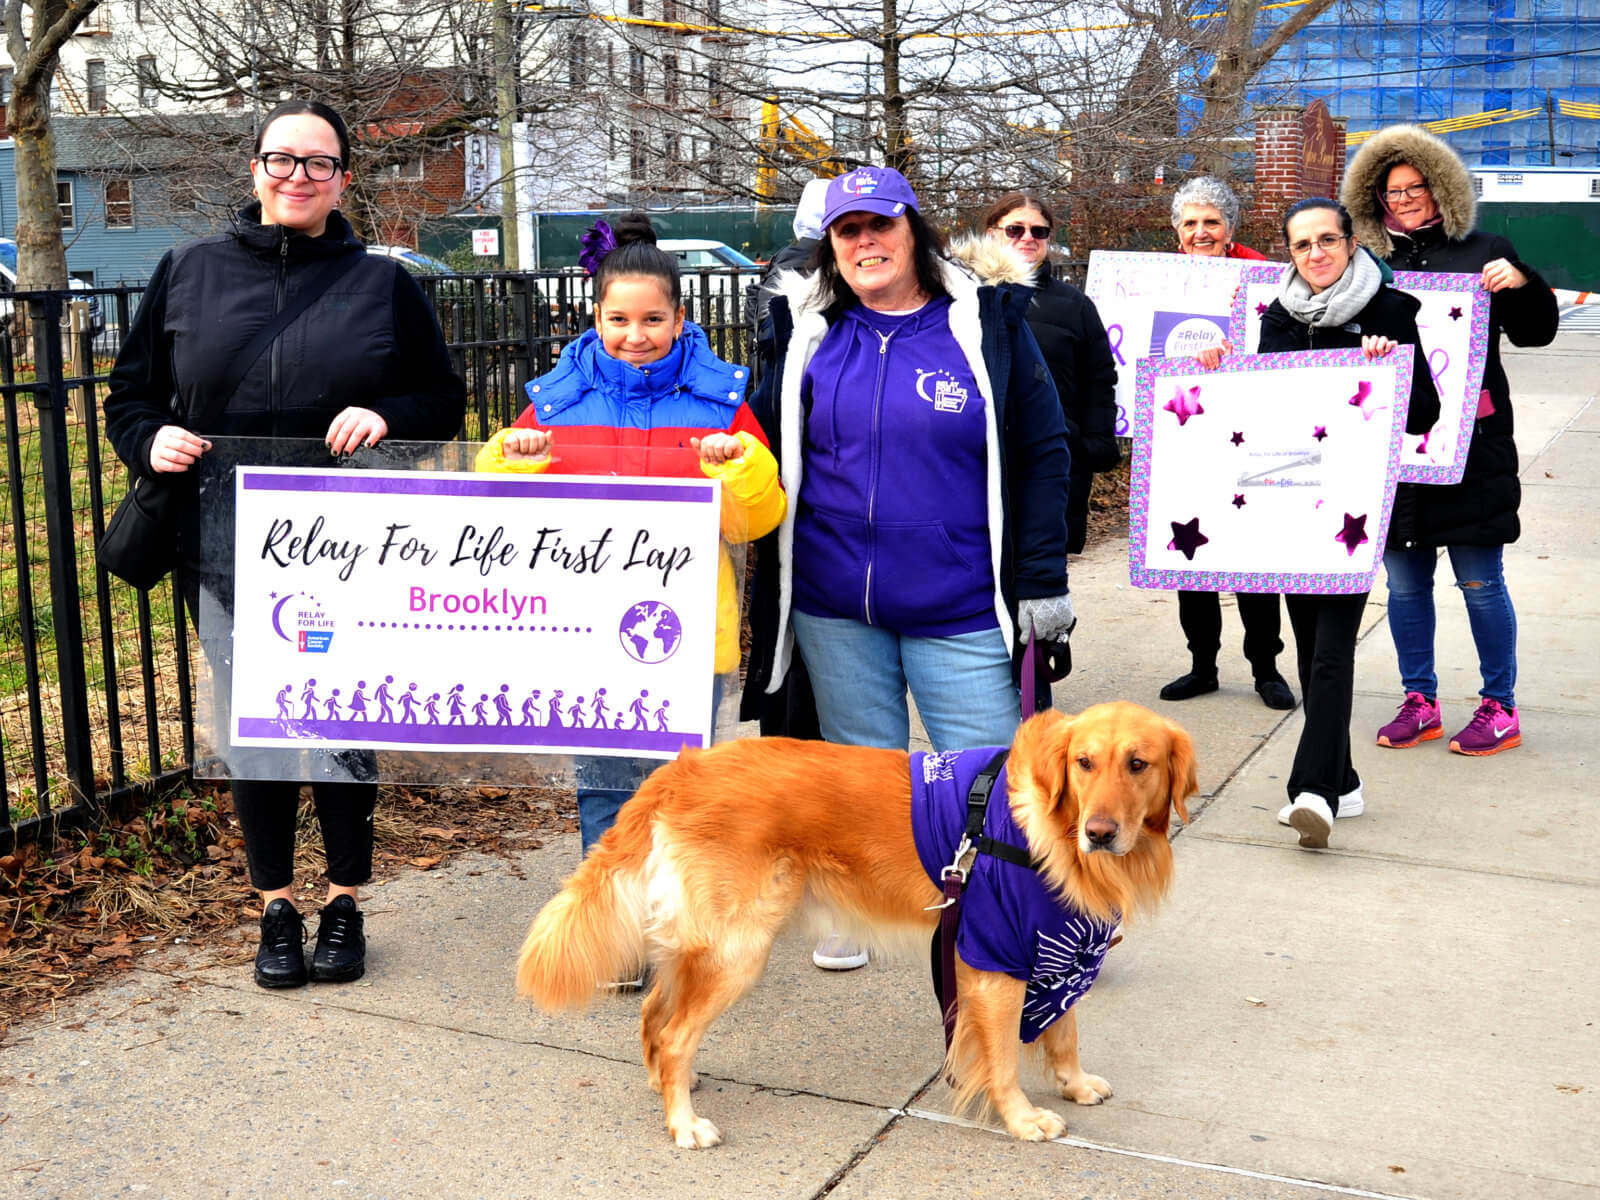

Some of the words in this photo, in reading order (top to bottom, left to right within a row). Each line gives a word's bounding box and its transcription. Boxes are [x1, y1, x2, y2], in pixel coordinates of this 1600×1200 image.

[1178, 329, 1216, 343] #Relay
[261, 515, 369, 582] Relay
[378, 523, 438, 566] For
[449, 525, 519, 576] Life
[528, 527, 613, 574] First
[622, 529, 695, 588] Lap
[409, 586, 547, 621] Brooklyn
[298, 611, 325, 619] RELAY
[298, 619, 315, 627] FOR
[318, 620, 335, 628] LIFE
